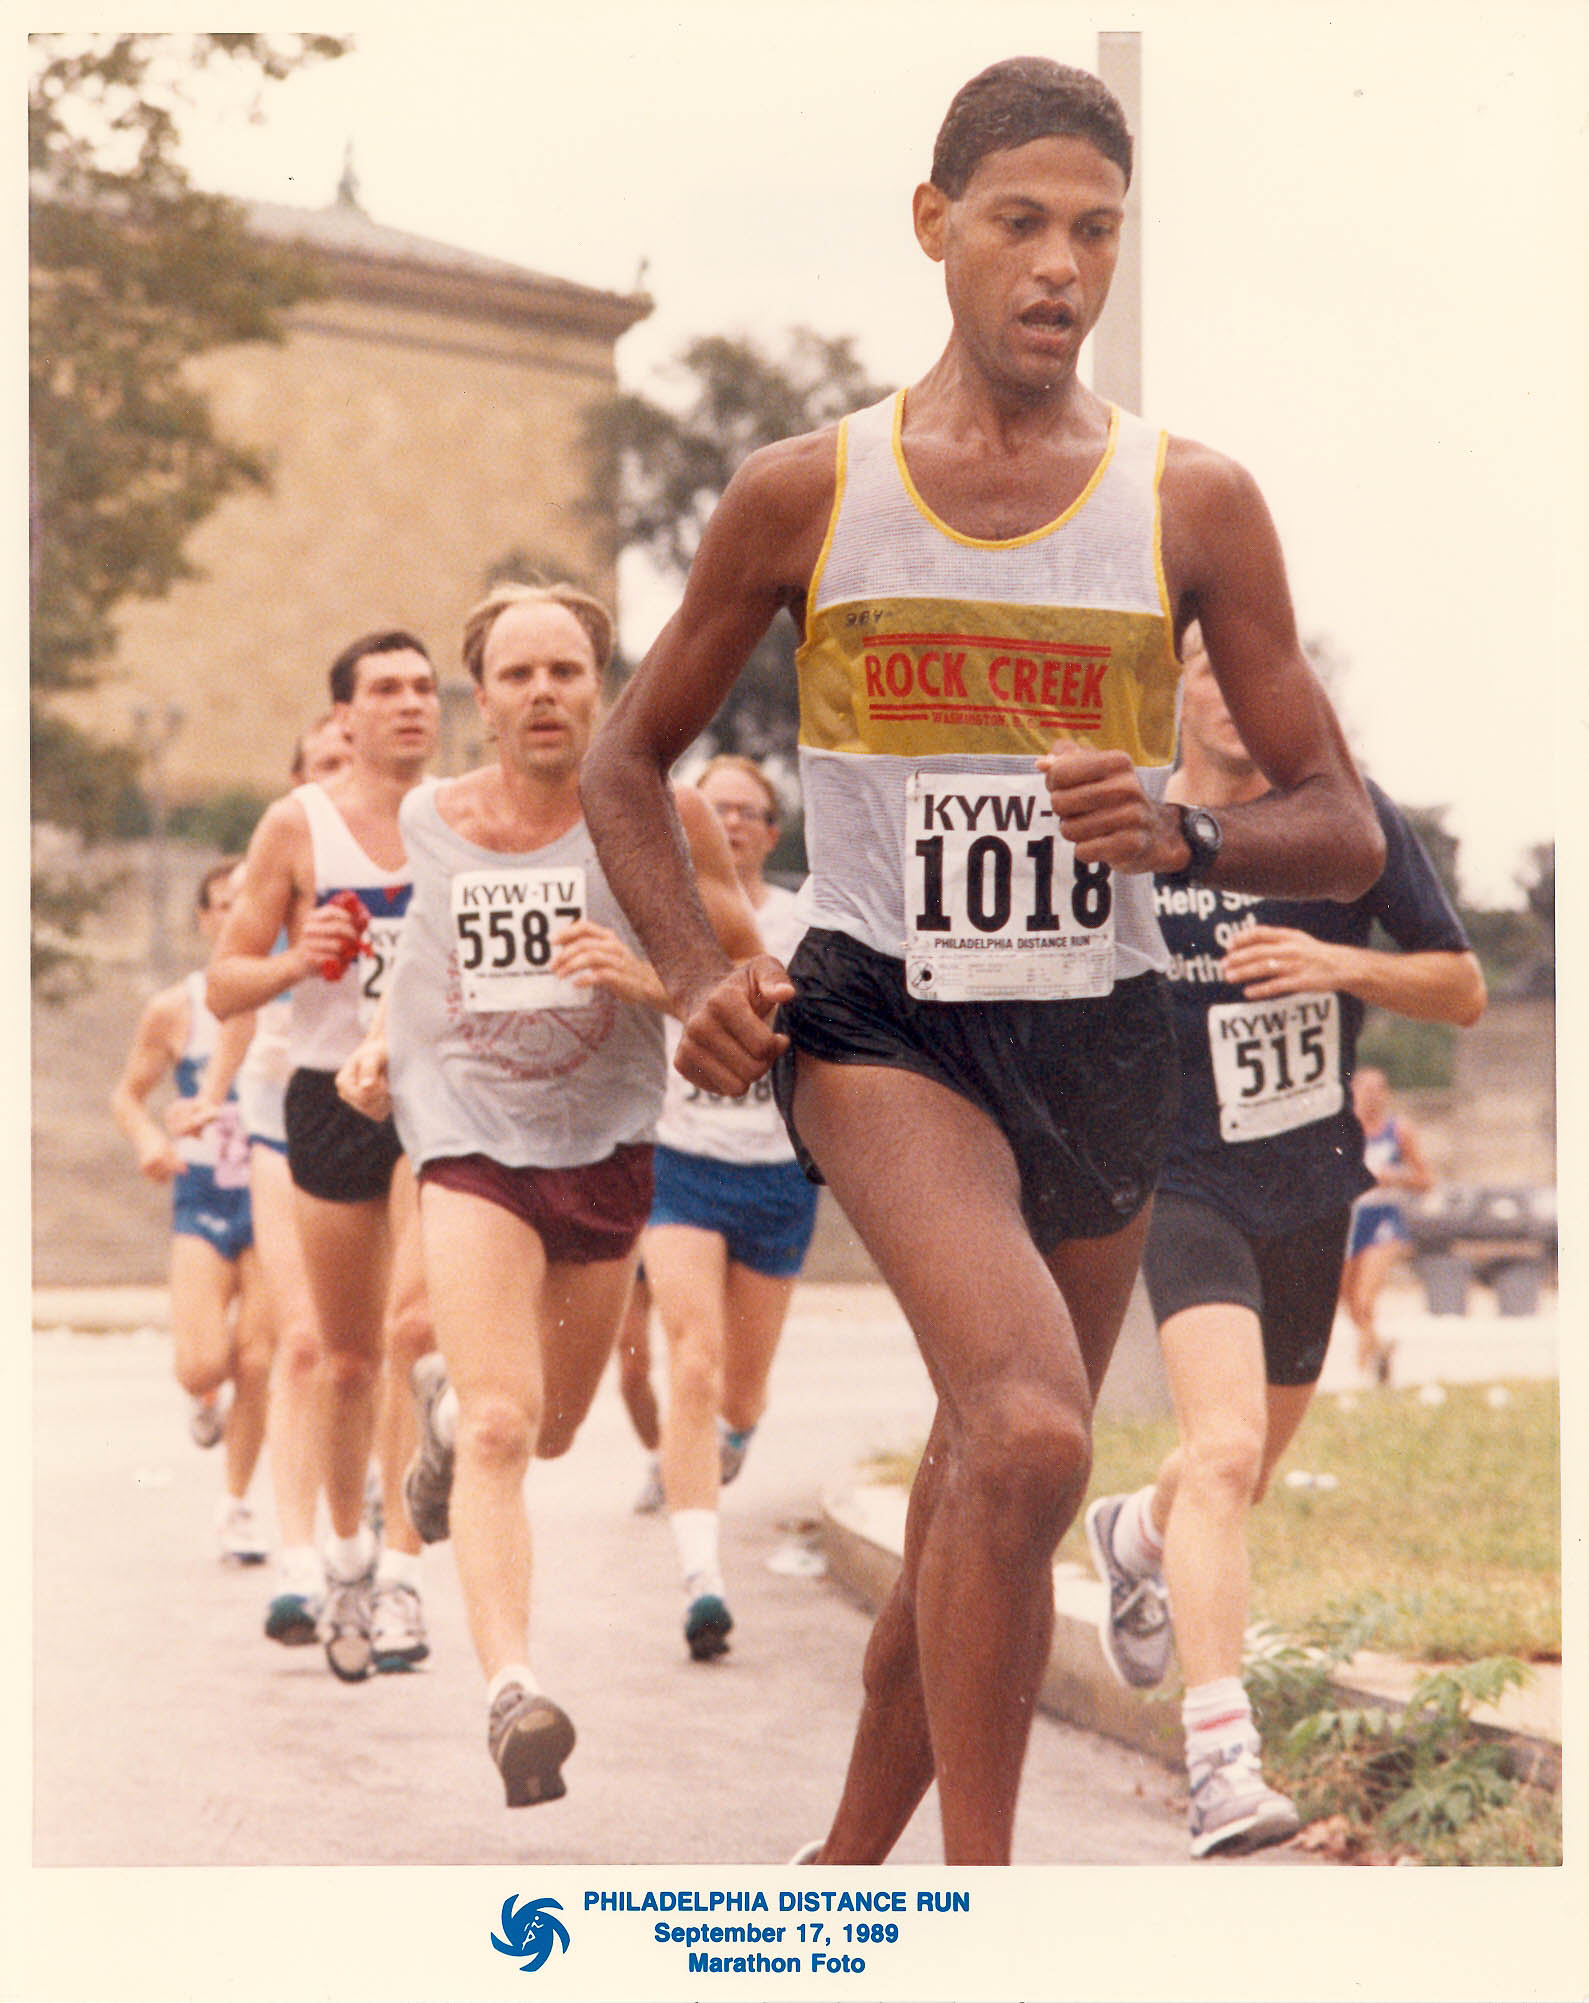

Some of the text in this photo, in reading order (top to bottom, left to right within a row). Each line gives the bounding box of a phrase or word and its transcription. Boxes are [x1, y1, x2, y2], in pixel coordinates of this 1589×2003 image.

[864, 652, 1109, 709] ROCK CREEK
[923, 794, 1054, 832] KYW-
[462, 881, 576, 906] KYW-TV
[915, 835, 1112, 932] 1018
[1152, 885, 1216, 921] Help
[934, 934, 1091, 950] PHILADELPHIA DISTANCE RUN
[1220, 1000, 1331, 1040] KYW-TV
[1235, 1026, 1326, 1098] 515
